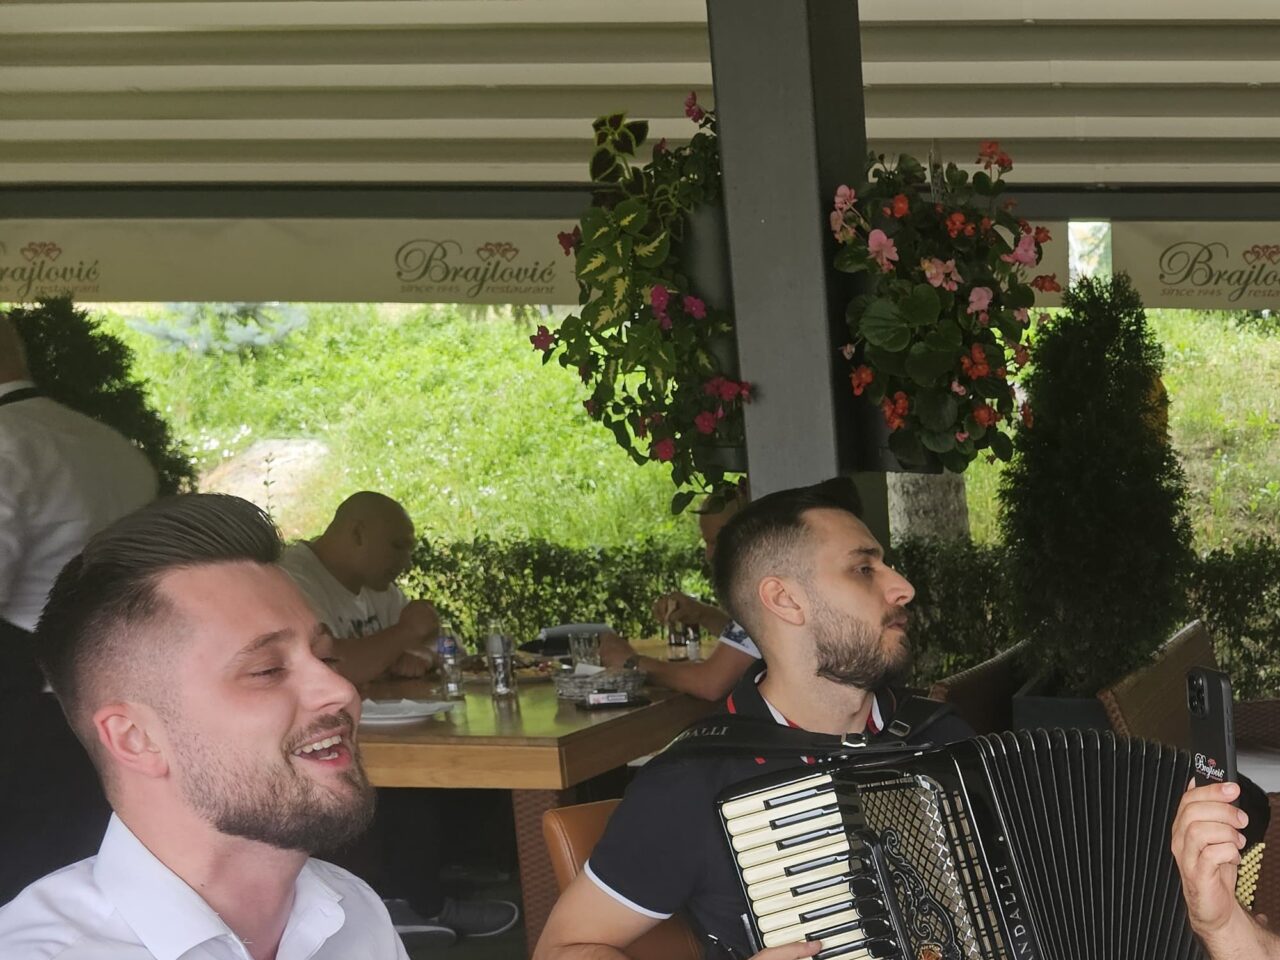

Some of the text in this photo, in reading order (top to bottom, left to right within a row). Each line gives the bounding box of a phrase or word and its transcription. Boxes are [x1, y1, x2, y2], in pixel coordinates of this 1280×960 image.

[0, 241, 99, 300] rajlović
[395, 239, 556, 298] Brajlović
[486, 285, 554, 294] restaurant
[1160, 287, 1195, 297] since
